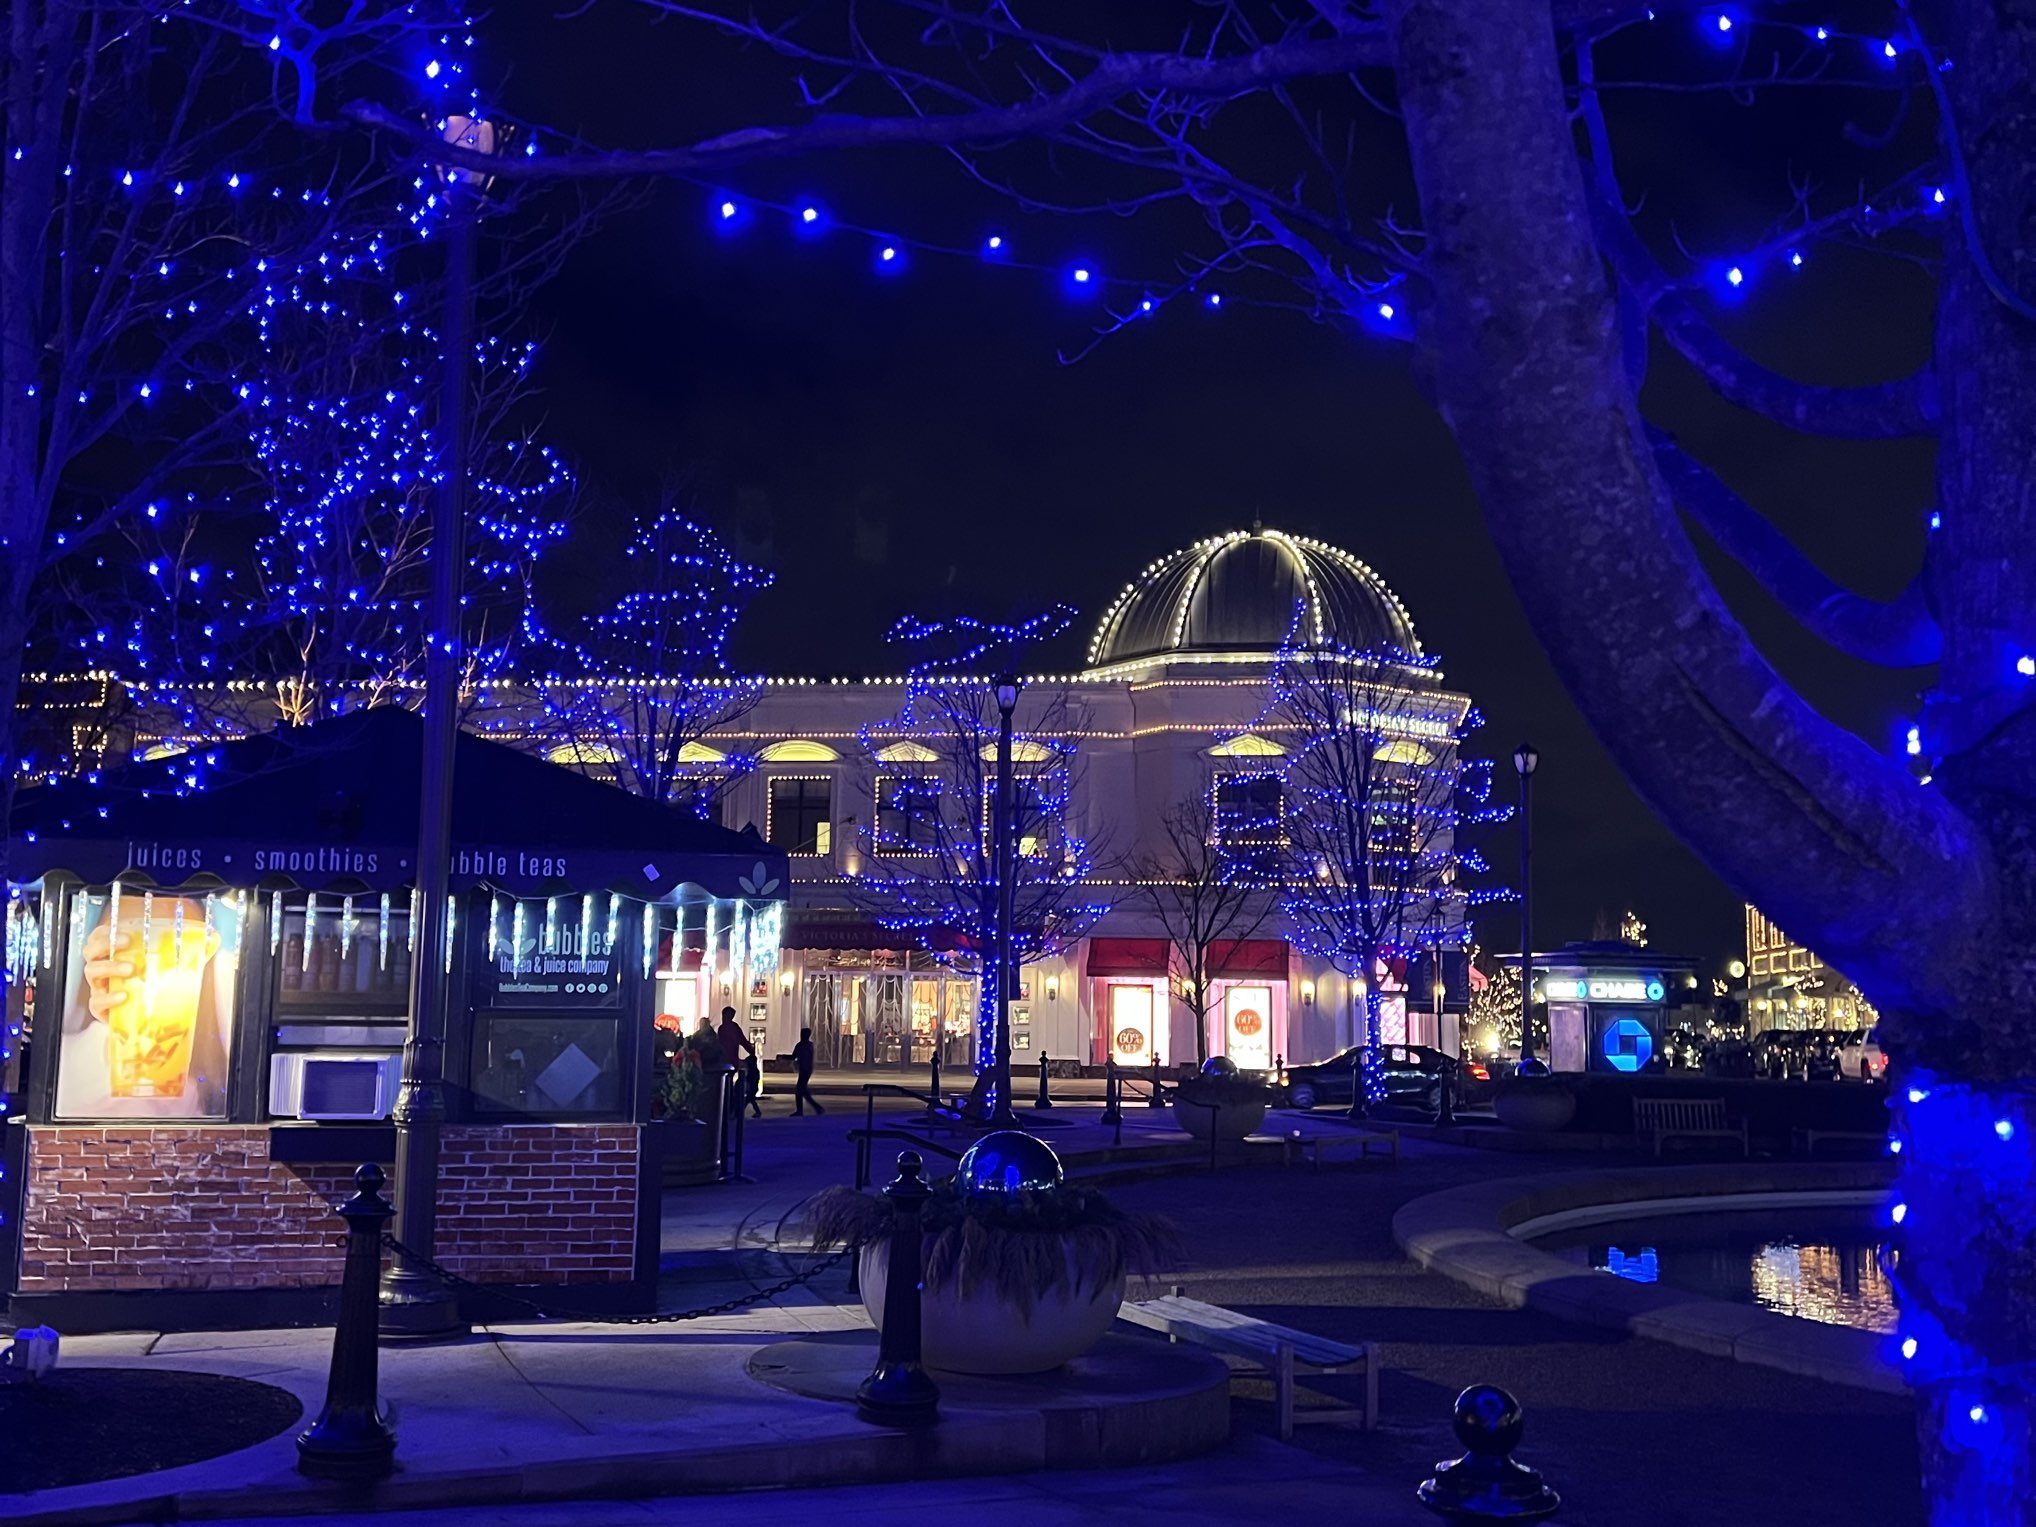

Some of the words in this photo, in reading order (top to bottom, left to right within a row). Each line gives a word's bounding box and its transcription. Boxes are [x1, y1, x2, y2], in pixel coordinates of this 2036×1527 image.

[127, 841, 201, 869] juices
[255, 848, 378, 872] smoothies
[519, 852, 566, 877] teas
[533, 956, 542, 974] &
[542, 956, 566, 976] juice
[568, 959, 609, 976] company
[1119, 1030, 1143, 1044] 60%
[1121, 1044, 1136, 1052] OFF
